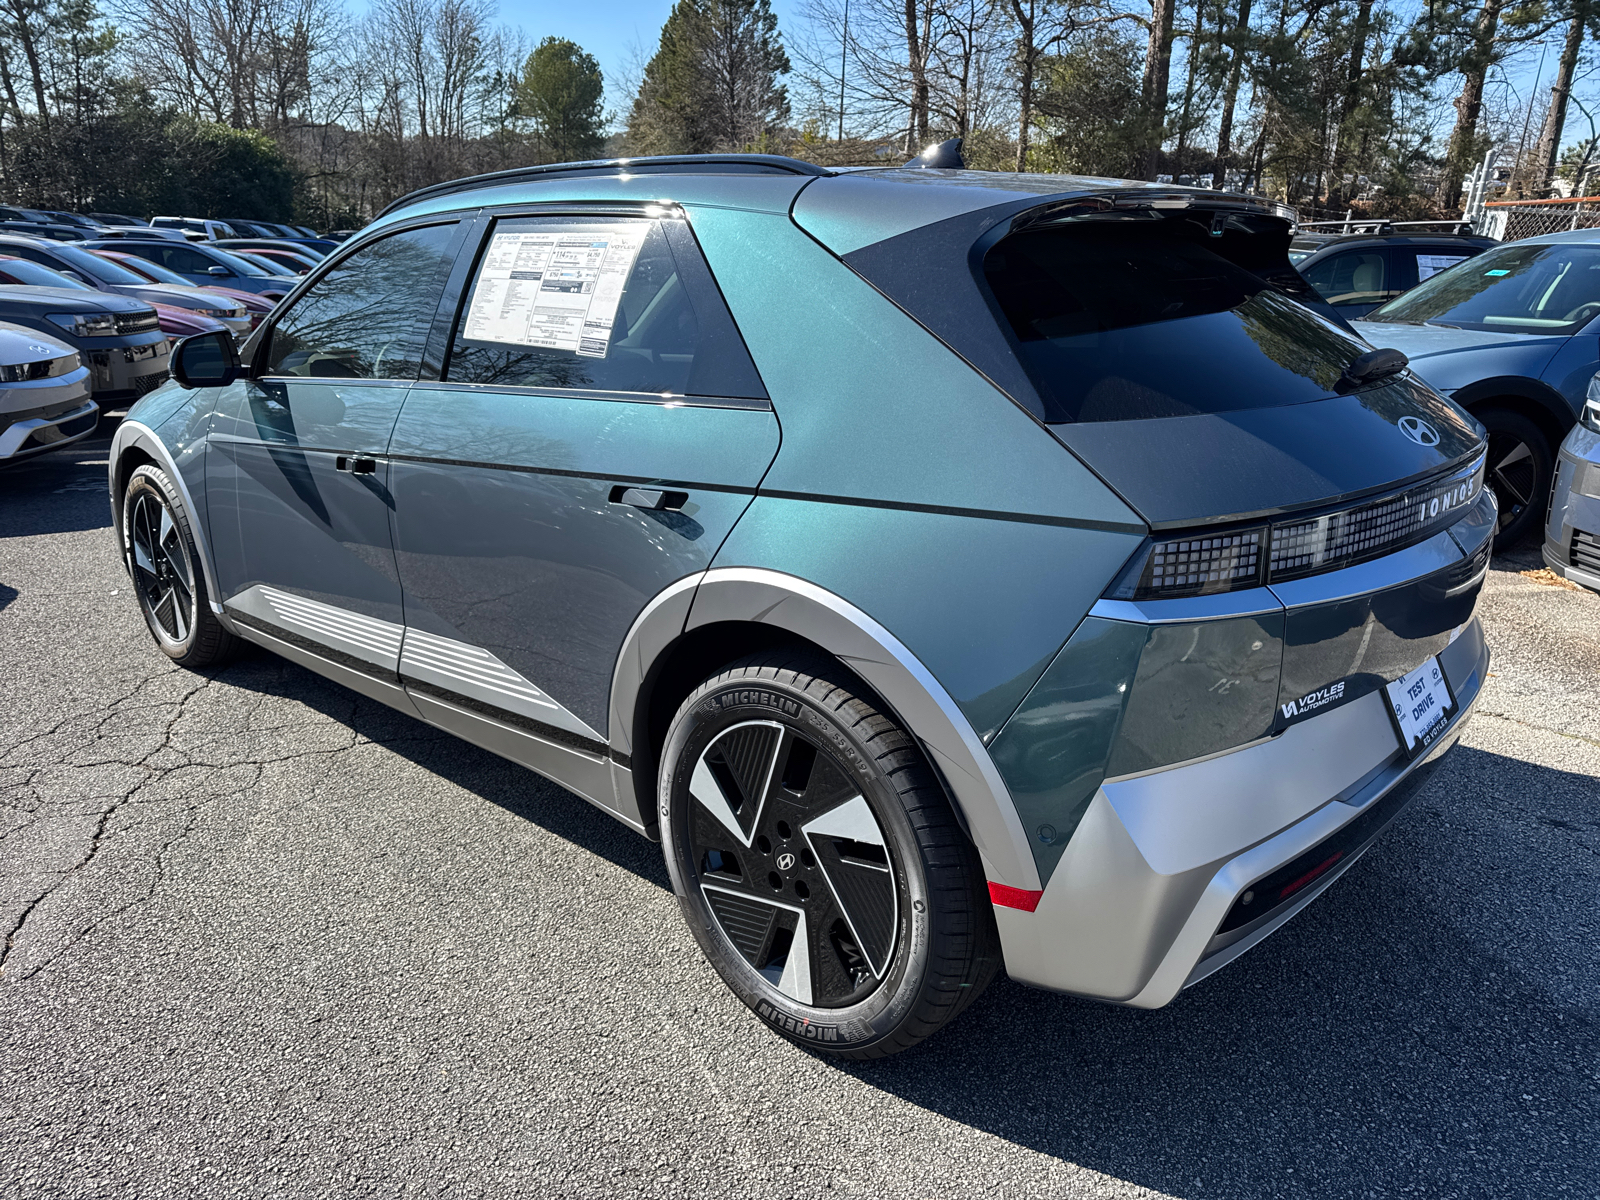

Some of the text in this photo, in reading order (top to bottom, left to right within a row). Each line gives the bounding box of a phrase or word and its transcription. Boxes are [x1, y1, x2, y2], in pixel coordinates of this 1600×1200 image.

[1298, 681, 1345, 707] VOYLES
[1406, 677, 1427, 701] TEST
[721, 691, 798, 715] MICHELIN
[1298, 691, 1344, 714] AUTOMOTIVE
[1411, 692, 1435, 722] DRIVE
[1423, 716, 1448, 745] ED VOYLES
[846, 746, 856, 758] R
[856, 758, 868, 773] 19
[758, 1002, 838, 1042] MICHELIN
